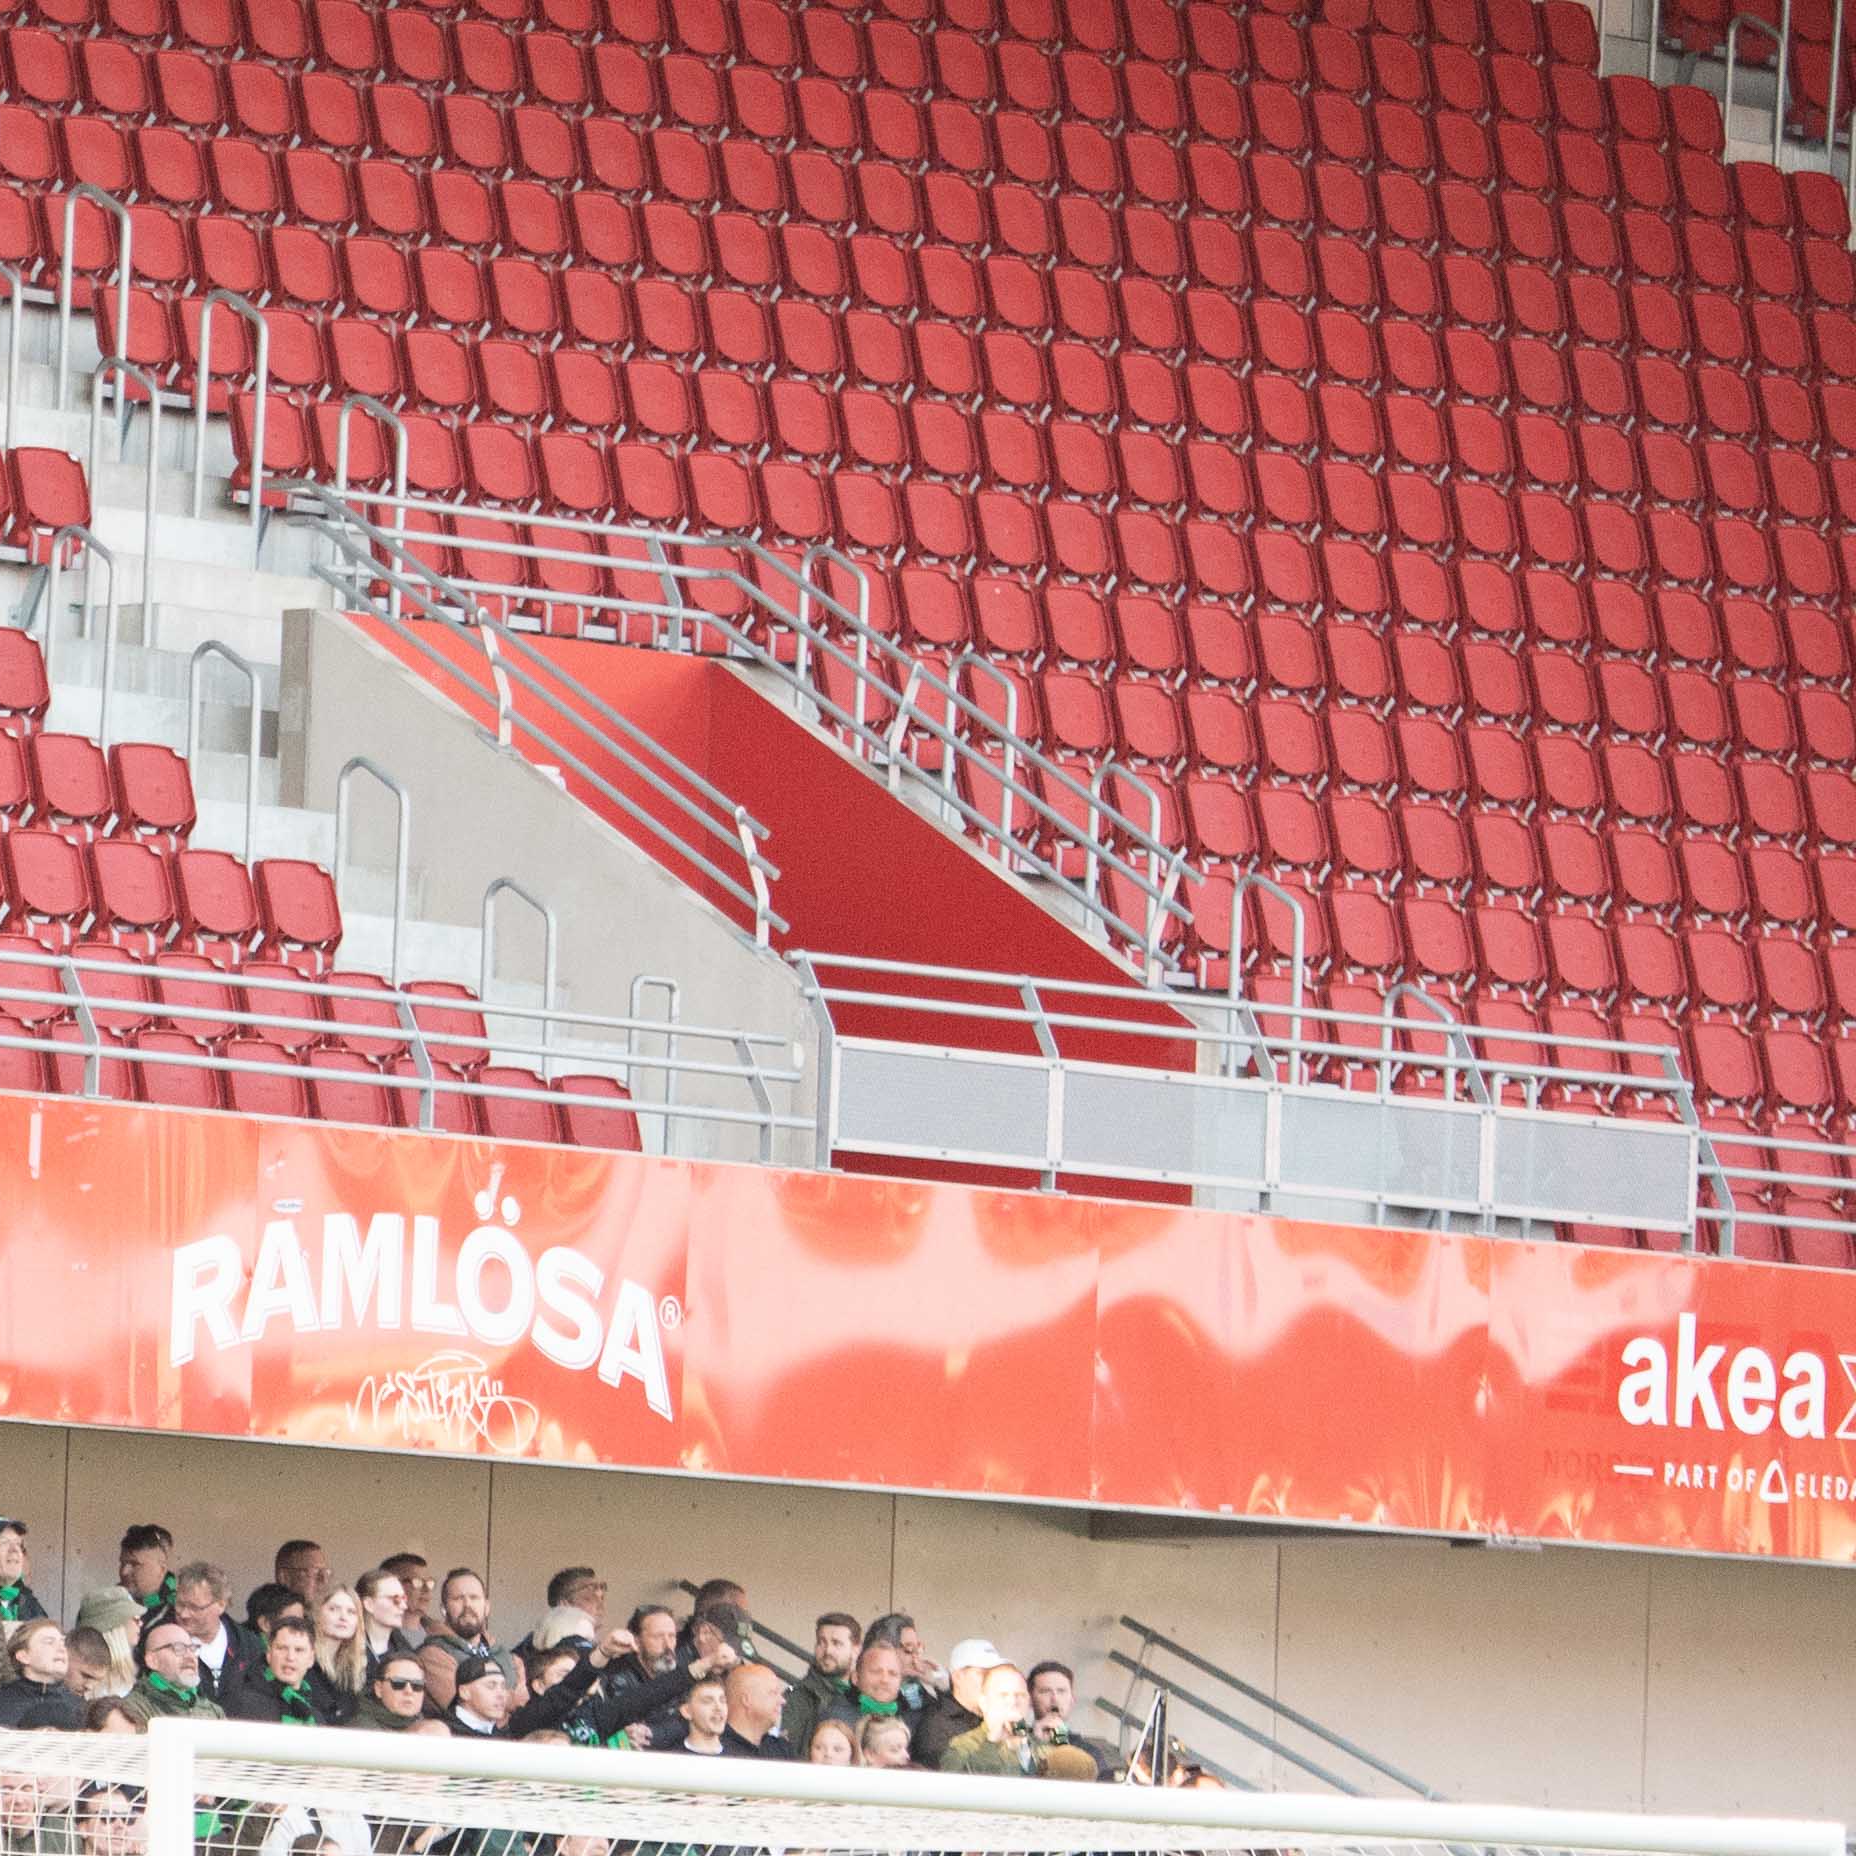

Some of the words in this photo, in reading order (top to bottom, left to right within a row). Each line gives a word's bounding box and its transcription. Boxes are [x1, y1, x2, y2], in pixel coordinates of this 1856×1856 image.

[169, 1189, 673, 1423] RAMLÖSA
[1664, 1462, 1718, 1489] PART
[1727, 1468, 1757, 1492] OF
